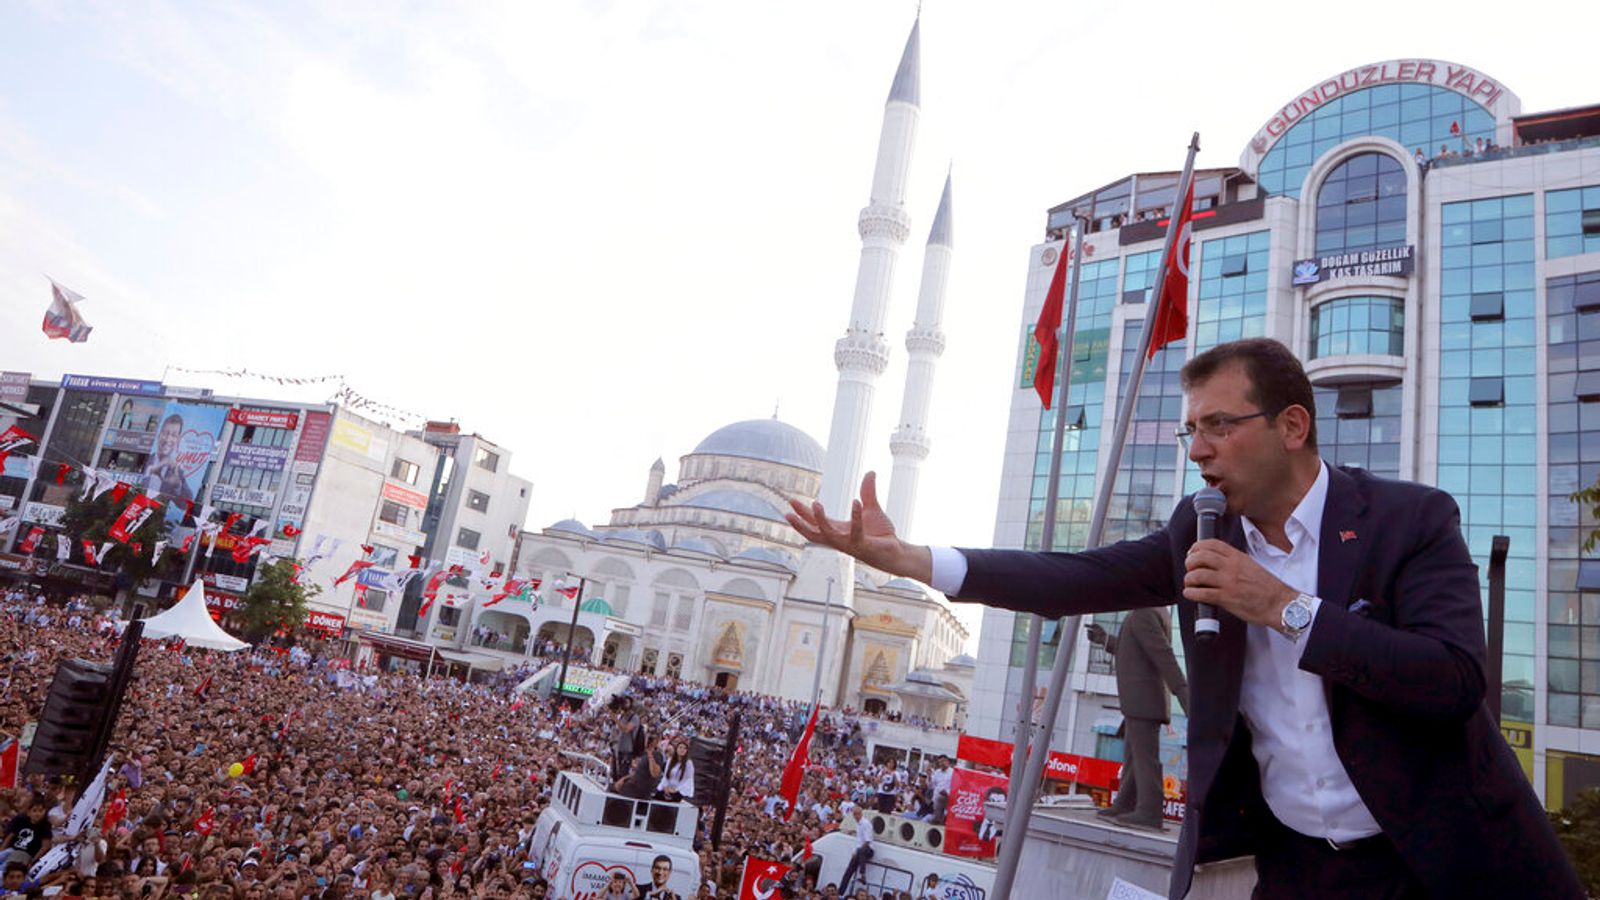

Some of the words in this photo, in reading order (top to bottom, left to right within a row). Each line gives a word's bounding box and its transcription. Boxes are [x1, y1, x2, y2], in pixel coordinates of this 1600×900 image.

[1267, 61, 1436, 137] GÜNDÜZLER
[1445, 65, 1503, 107] YAPI
[176, 452, 209, 464] UMUT
[1047, 758, 1077, 774] afone
